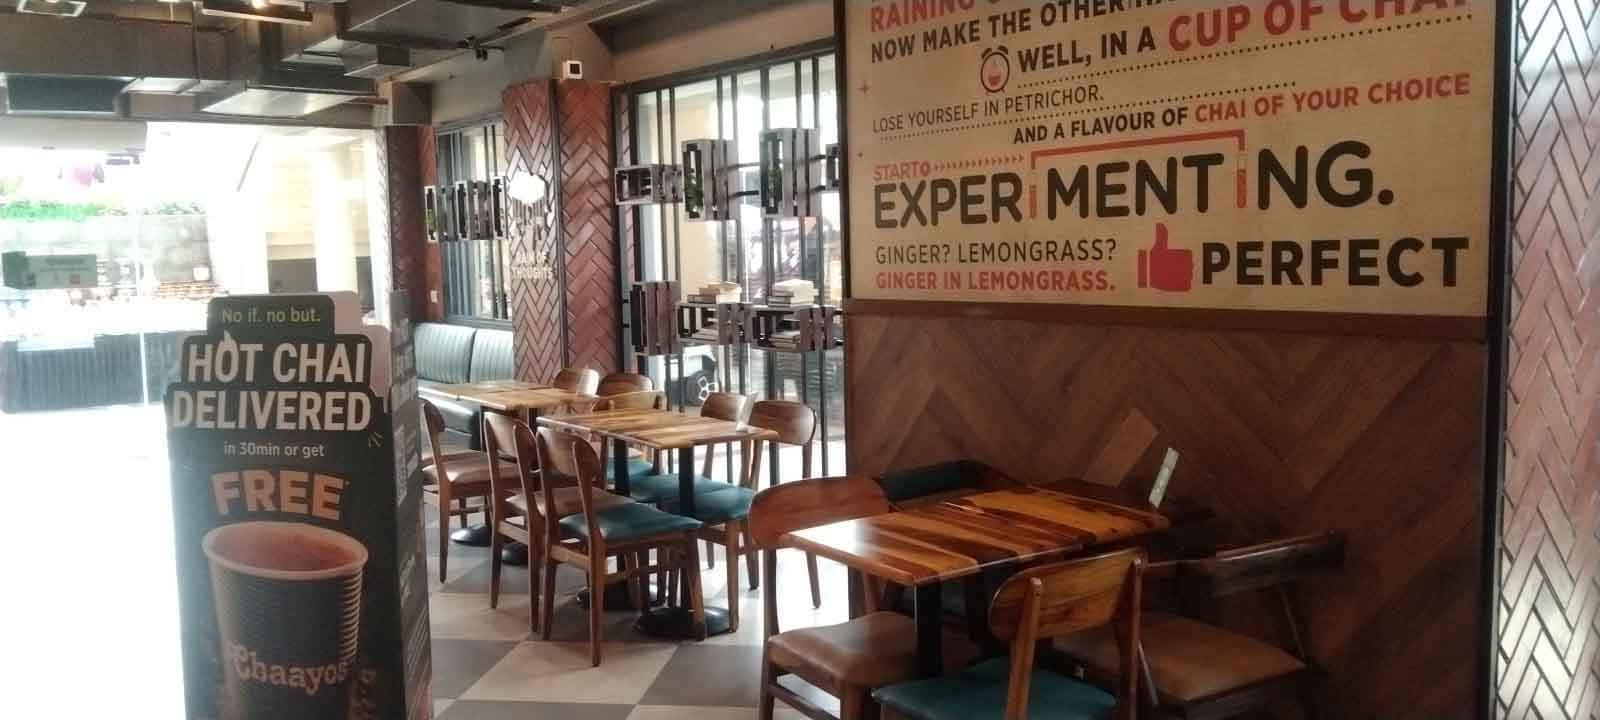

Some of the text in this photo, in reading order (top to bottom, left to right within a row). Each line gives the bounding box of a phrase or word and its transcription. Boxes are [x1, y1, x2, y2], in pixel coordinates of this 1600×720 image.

[871, 34, 915, 63] NOW
[923, 19, 980, 52] MAKE
[988, 8, 1032, 37] THE
[1017, 39, 1092, 73] WELL,
[1101, 30, 1128, 59] IN
[1137, 26, 1156, 53] A
[1168, 6, 1250, 51] CUP
[1263, 0, 1323, 36] OF
[872, 84, 1104, 133] LOSE YOURSELF IN PETRICHOR.
[1013, 73, 1471, 144] AND A FLAVOUR OF CHAI OF YOUR CHOICE
[875, 238, 1117, 265] GINGER? LEMONGRASS?
[1202, 237, 1470, 288] PERFECT
[875, 270, 1116, 291] GINGER IN LEMONGRASS.
[222, 308, 242, 323] No
[266, 311, 285, 322] no
[290, 306, 321, 323] but.
[187, 343, 264, 384] HOT
[272, 342, 366, 384] CHAI
[172, 390, 372, 432] DELIVERED
[224, 442, 325, 458] in 30min or get
